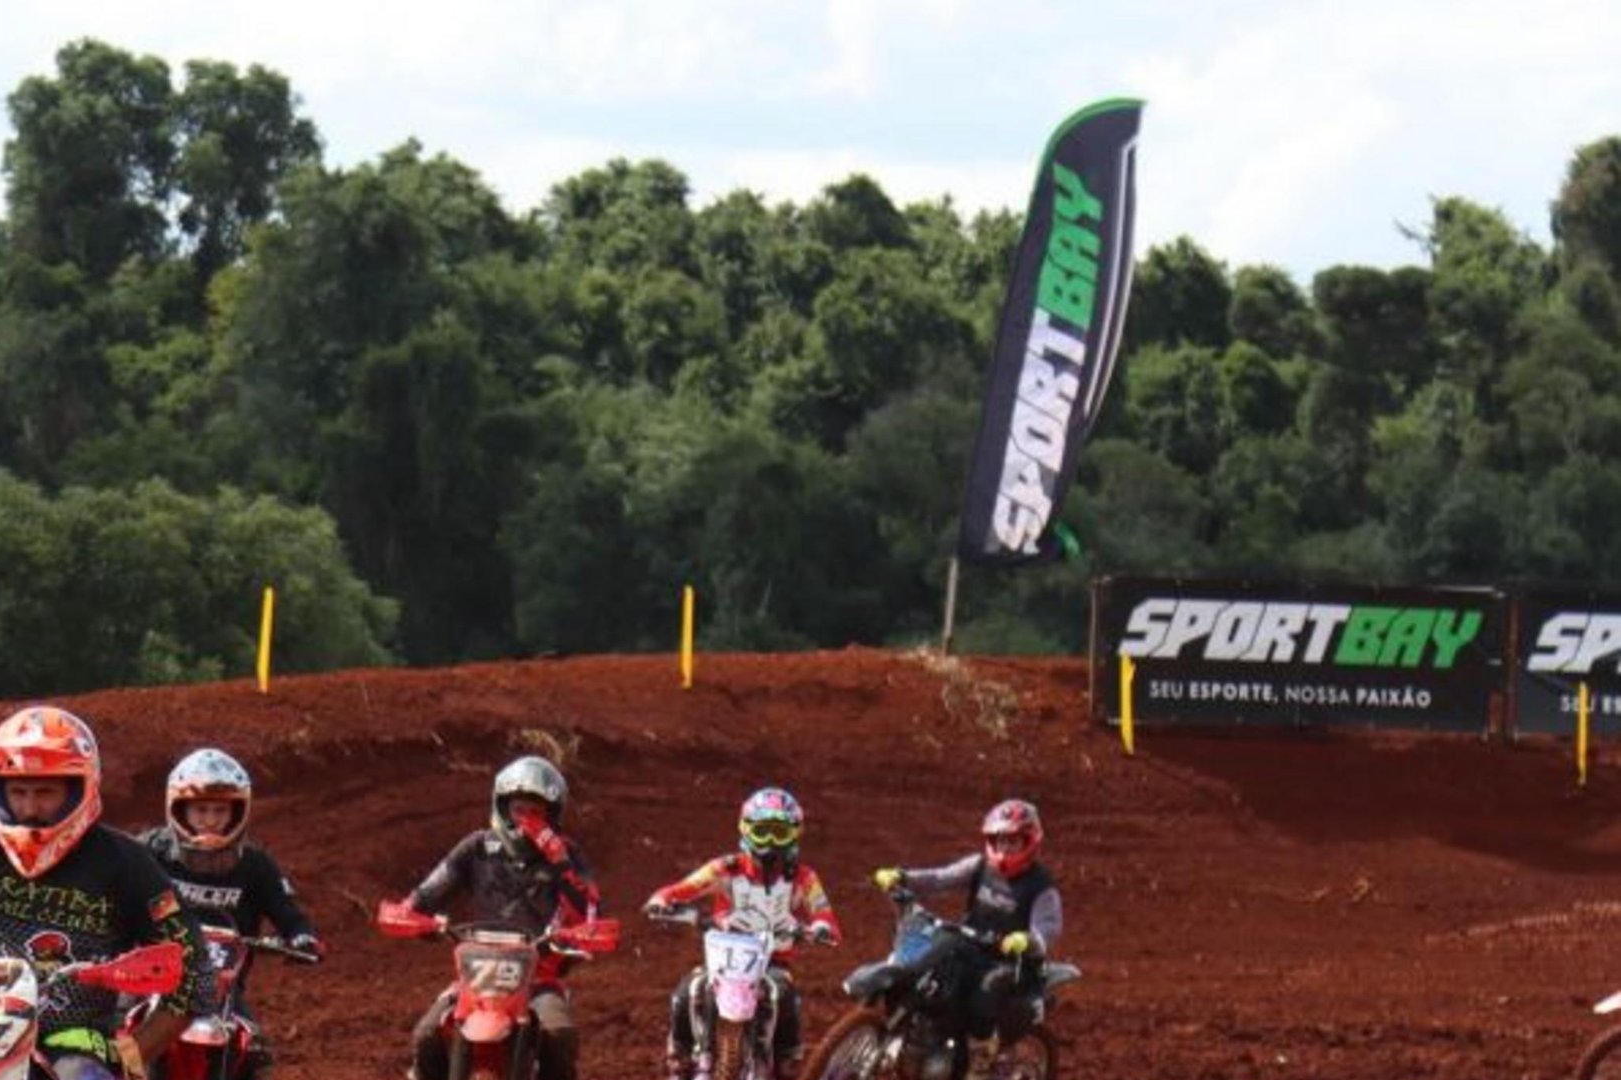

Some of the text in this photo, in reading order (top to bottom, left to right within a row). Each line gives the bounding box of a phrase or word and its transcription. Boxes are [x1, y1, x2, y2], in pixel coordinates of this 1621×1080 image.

[992, 162, 1103, 554] SPORTBAY
[1118, 599, 1483, 669] SPORTBAY
[1527, 612, 1621, 674] SP
[1149, 681, 1432, 709] SEU ESPORTE, NOSSA PAIXÃO
